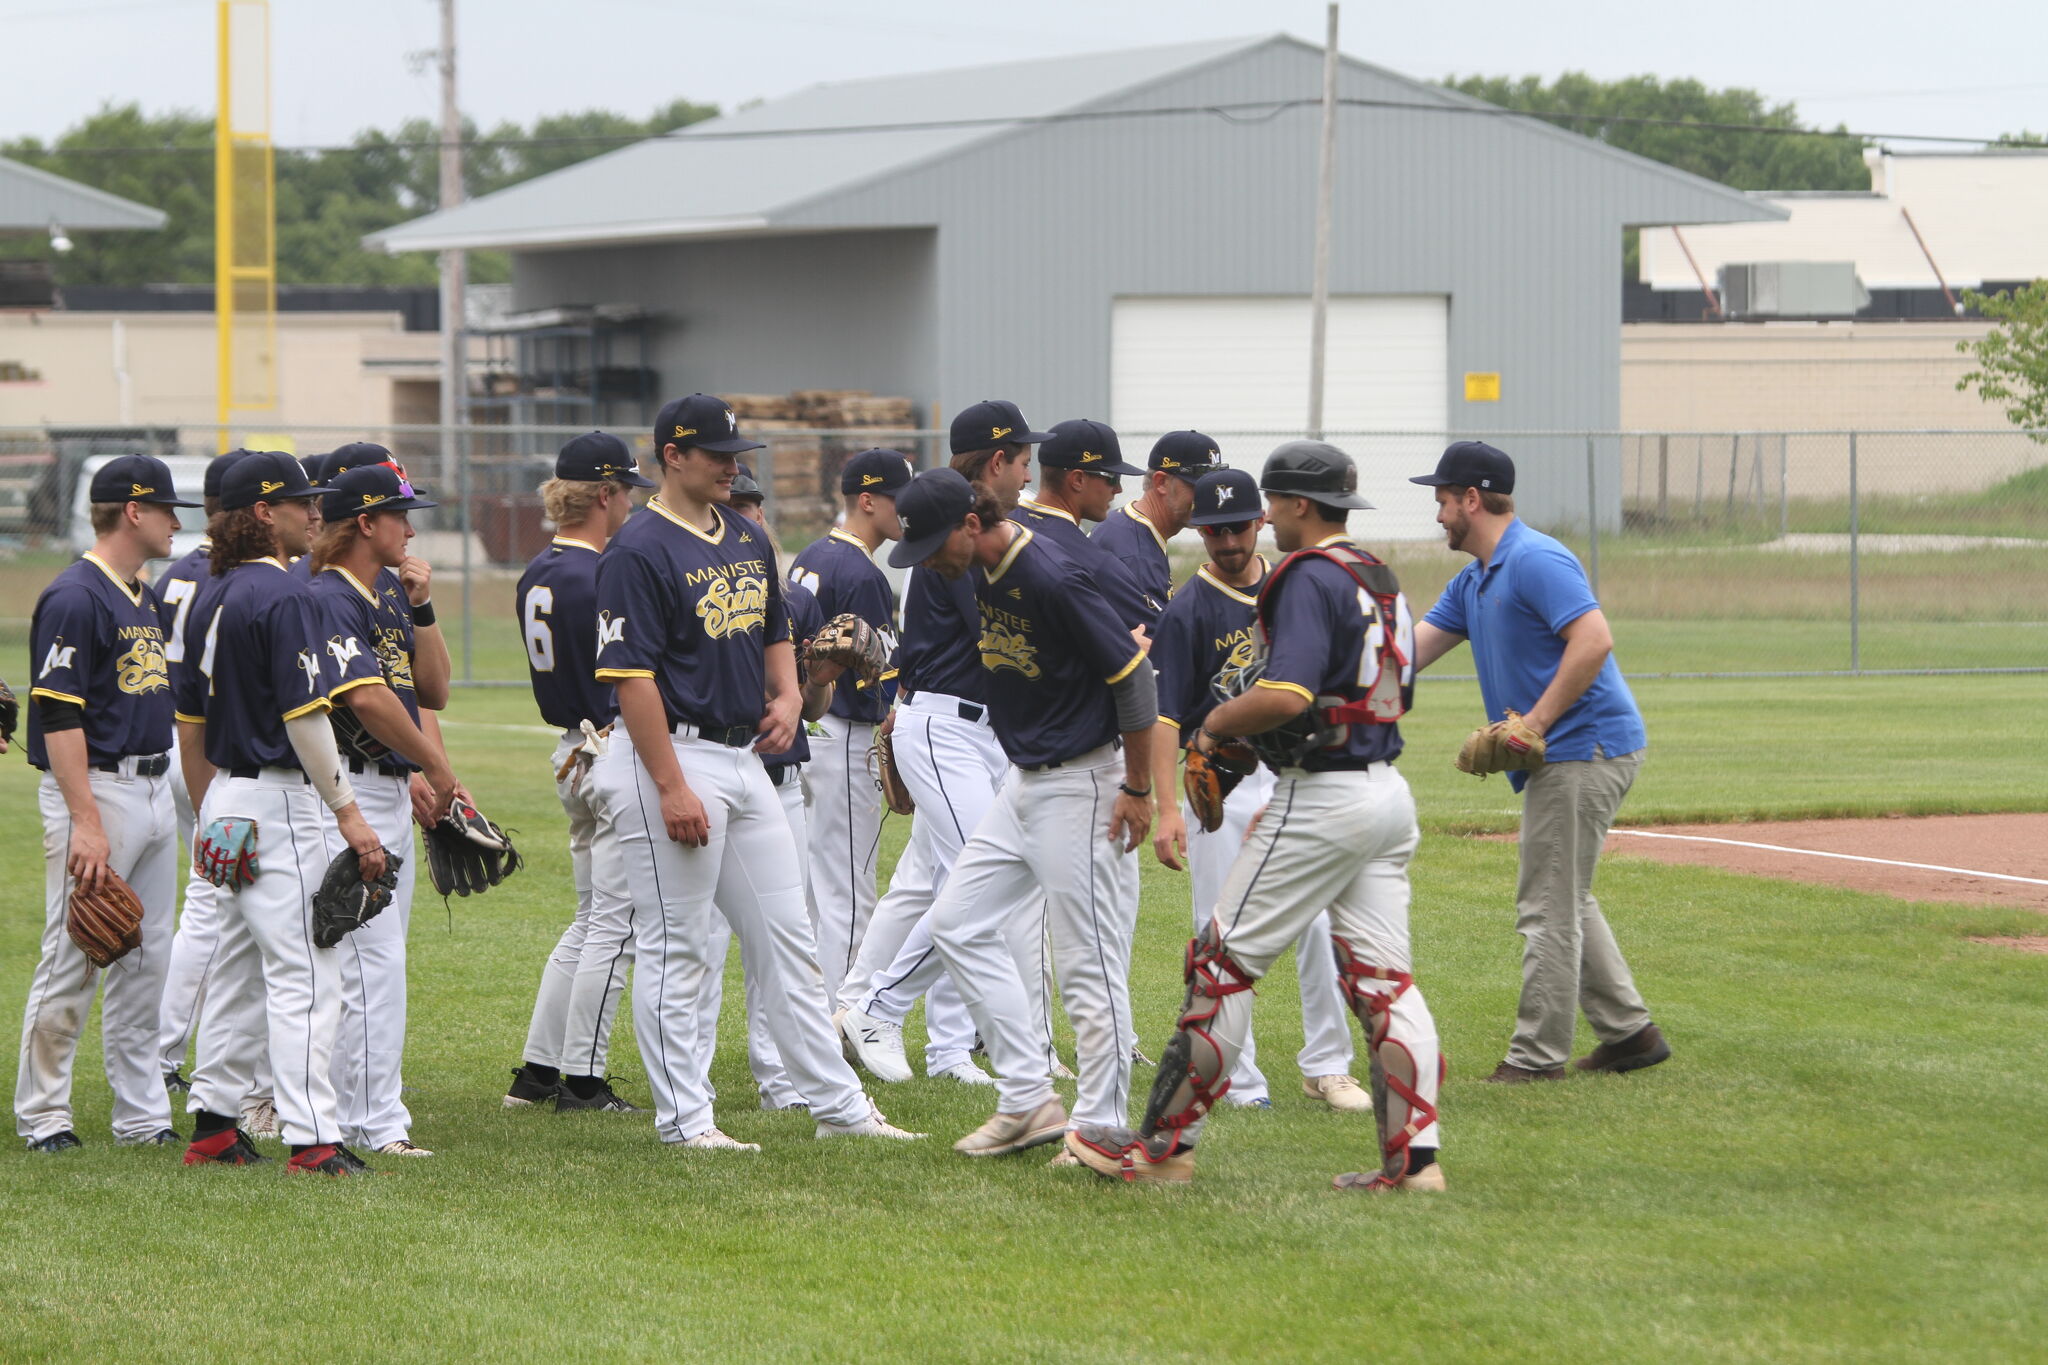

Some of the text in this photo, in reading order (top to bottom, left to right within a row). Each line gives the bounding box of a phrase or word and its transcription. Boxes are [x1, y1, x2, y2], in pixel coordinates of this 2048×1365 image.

[1216, 485, 1234, 508] M
[525, 585, 555, 672] 6
[597, 610, 626, 661] M
[38, 641, 77, 680] M
[326, 635, 362, 678] M
